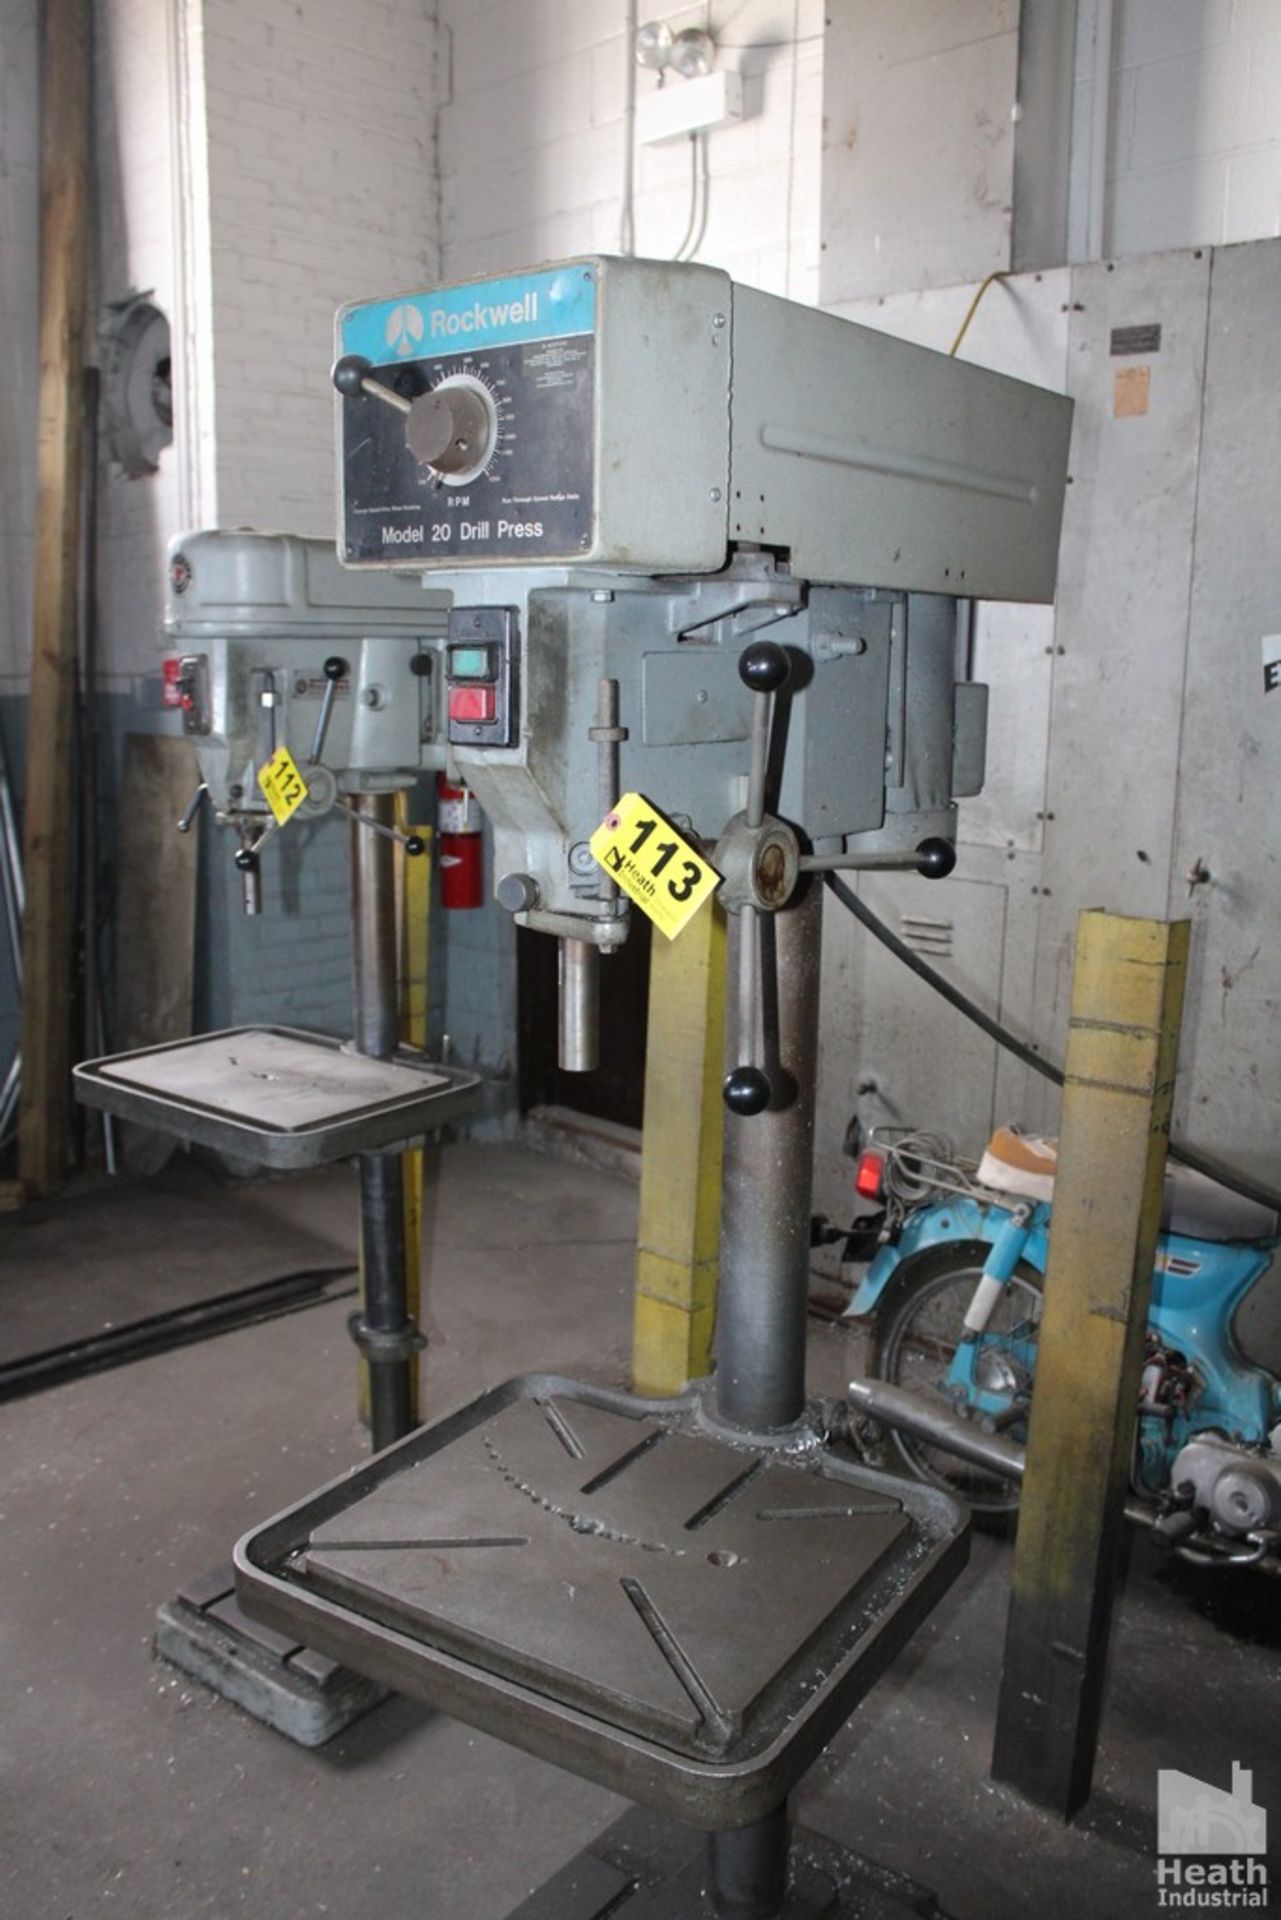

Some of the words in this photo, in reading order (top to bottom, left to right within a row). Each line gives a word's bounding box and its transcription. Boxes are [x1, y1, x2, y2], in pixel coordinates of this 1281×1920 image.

[430, 292, 538, 338] Rockwell
[447, 496, 470, 507] RPM
[382, 525, 424, 544] Model
[431, 523, 452, 543] 20
[460, 521, 490, 541] Drill
[497, 519, 544, 539] Press
[275, 761, 301, 807] 112
[624, 860, 656, 897] Heath
[629, 819, 702, 903] 113
